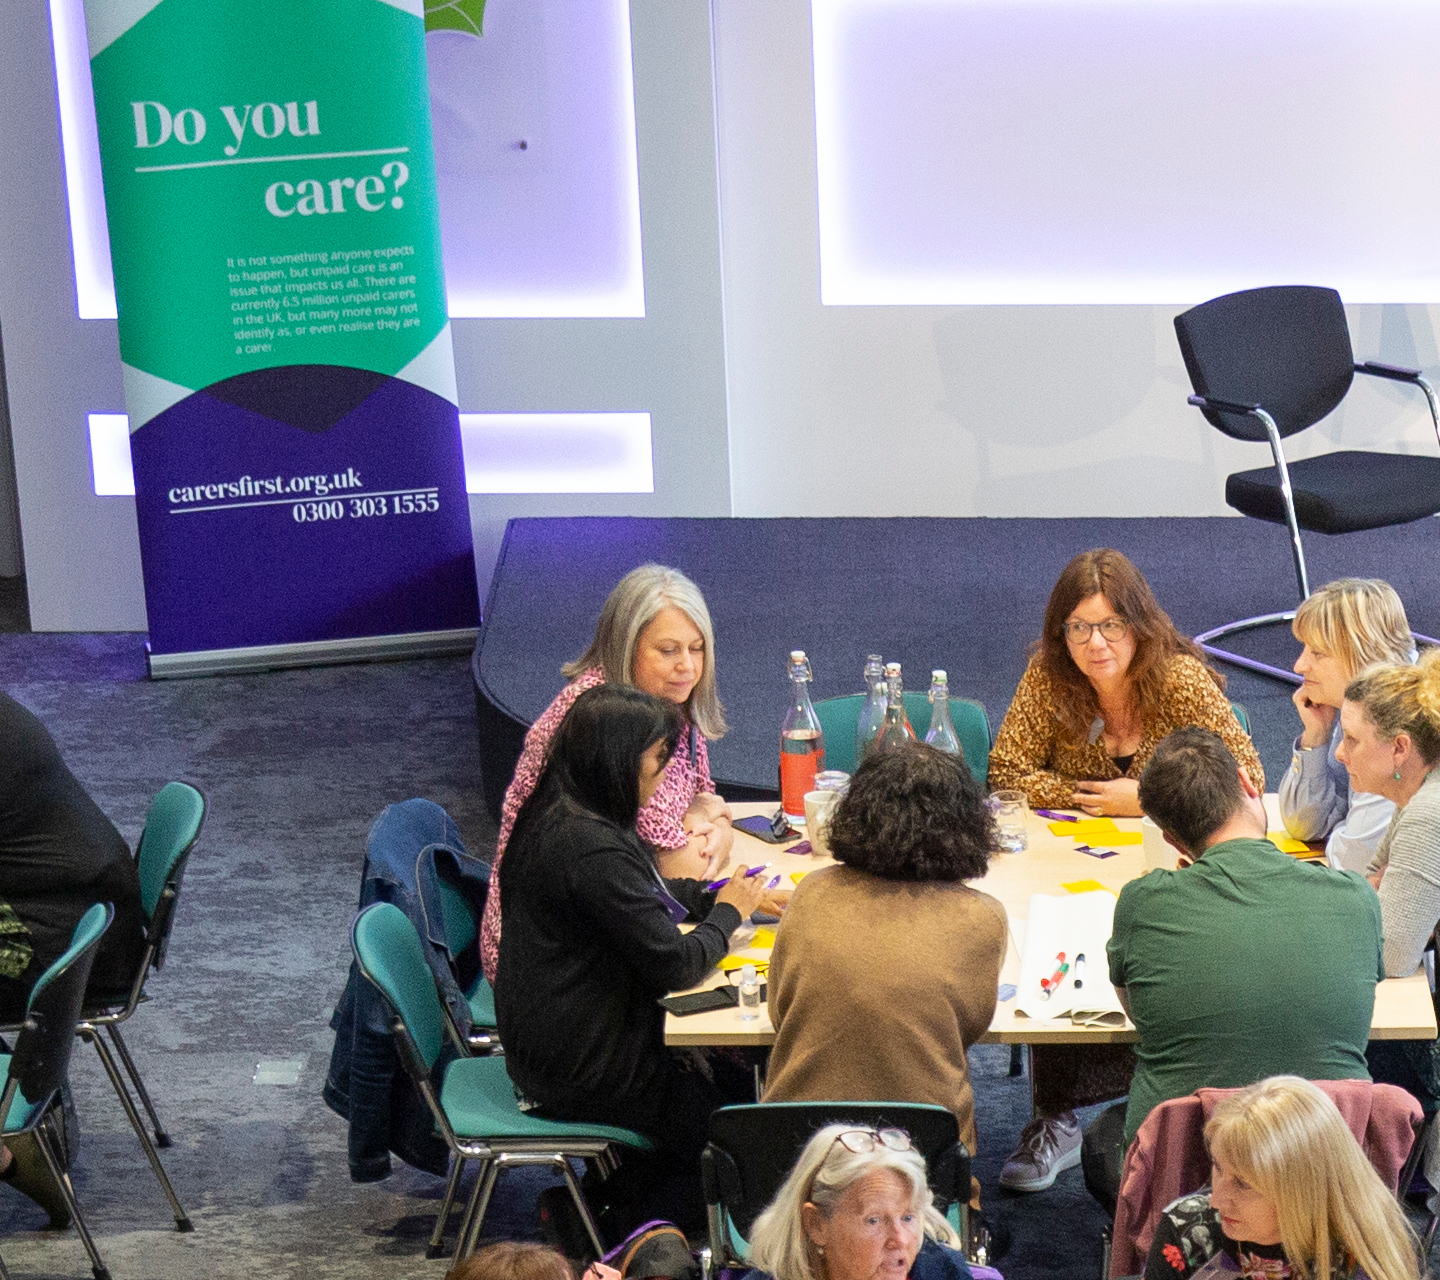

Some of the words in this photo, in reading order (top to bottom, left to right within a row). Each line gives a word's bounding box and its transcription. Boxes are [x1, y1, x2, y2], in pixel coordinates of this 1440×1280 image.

[130, 100, 207, 148] Do
[219, 100, 321, 156] you
[264, 161, 409, 218] care?
[227, 258, 234, 268] It
[238, 258, 246, 267] is
[249, 256, 267, 266] not
[270, 251, 328, 264] something
[331, 249, 371, 261] anyone
[374, 246, 415, 259] expects
[229, 273, 240, 282] to
[290, 267, 309, 277] but
[312, 264, 349, 277] unpaid
[352, 263, 375, 274] care
[378, 262, 387, 272] is
[389, 262, 403, 271] an
[230, 286, 258, 296] issue
[260, 284, 282, 294] that
[285, 280, 328, 293] impacts
[331, 280, 343, 290] us
[365, 276, 396, 287] There
[398, 275, 416, 285] are
[231, 298, 279, 311] currently
[283, 297, 300, 307] 6.5
[302, 295, 339, 305] million
[342, 291, 379, 304] unpaid
[382, 289, 415, 301] carers
[233, 315, 243, 325] in
[246, 313, 263, 324] the
[288, 311, 306, 322] but
[309, 309, 339, 321] many
[342, 307, 371, 318] more
[374, 305, 398, 316] may
[400, 302, 418, 313] not
[234, 327, 274, 340] identify
[295, 324, 307, 335] or
[309, 324, 336, 334] even
[338, 320, 374, 332] realise
[377, 319, 400, 331] they
[403, 317, 420, 328] are
[236, 345, 242, 354] a
[168, 467, 362, 503] carersfirst.org.uk
[293, 500, 344, 523] 0300
[350, 497, 387, 519] 303
[393, 493, 439, 515] 1555
